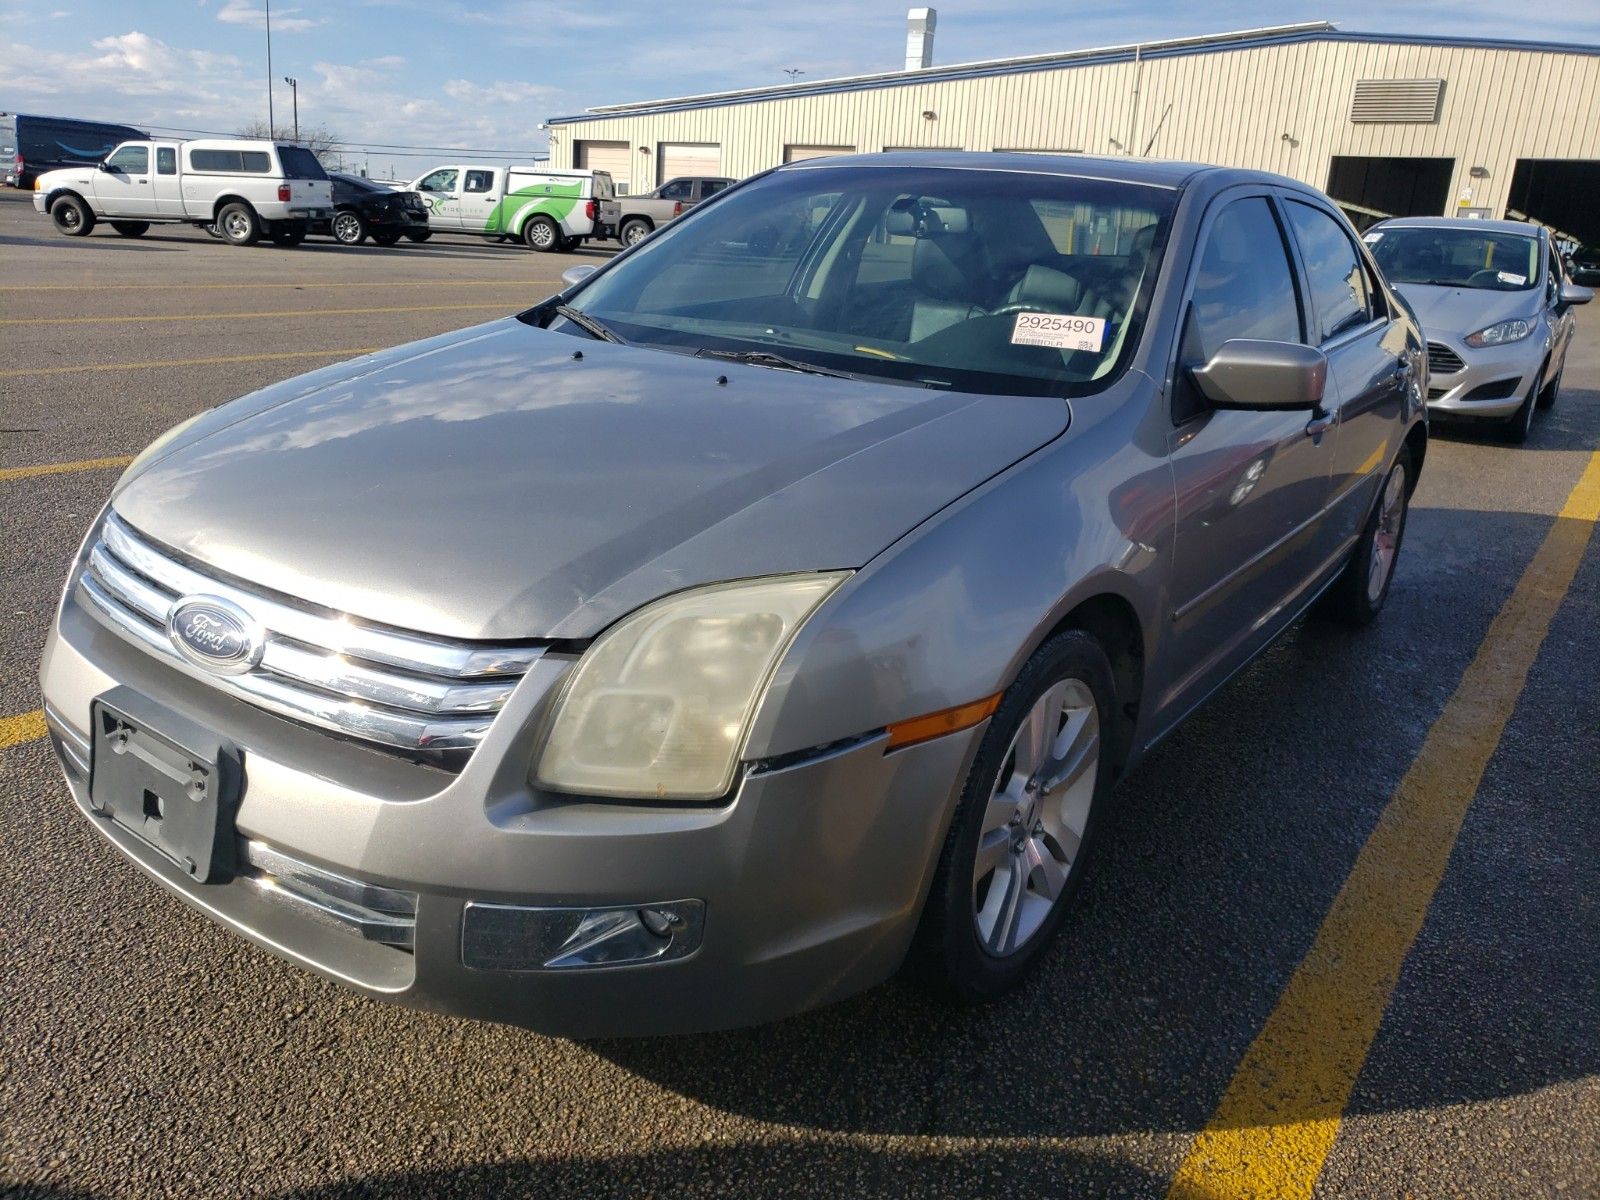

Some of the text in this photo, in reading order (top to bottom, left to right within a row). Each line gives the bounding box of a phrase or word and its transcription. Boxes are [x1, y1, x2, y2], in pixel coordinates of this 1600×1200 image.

[1018, 316, 1095, 334] 2925490
[1044, 339, 1063, 347] DLR
[185, 613, 229, 651] Ford
